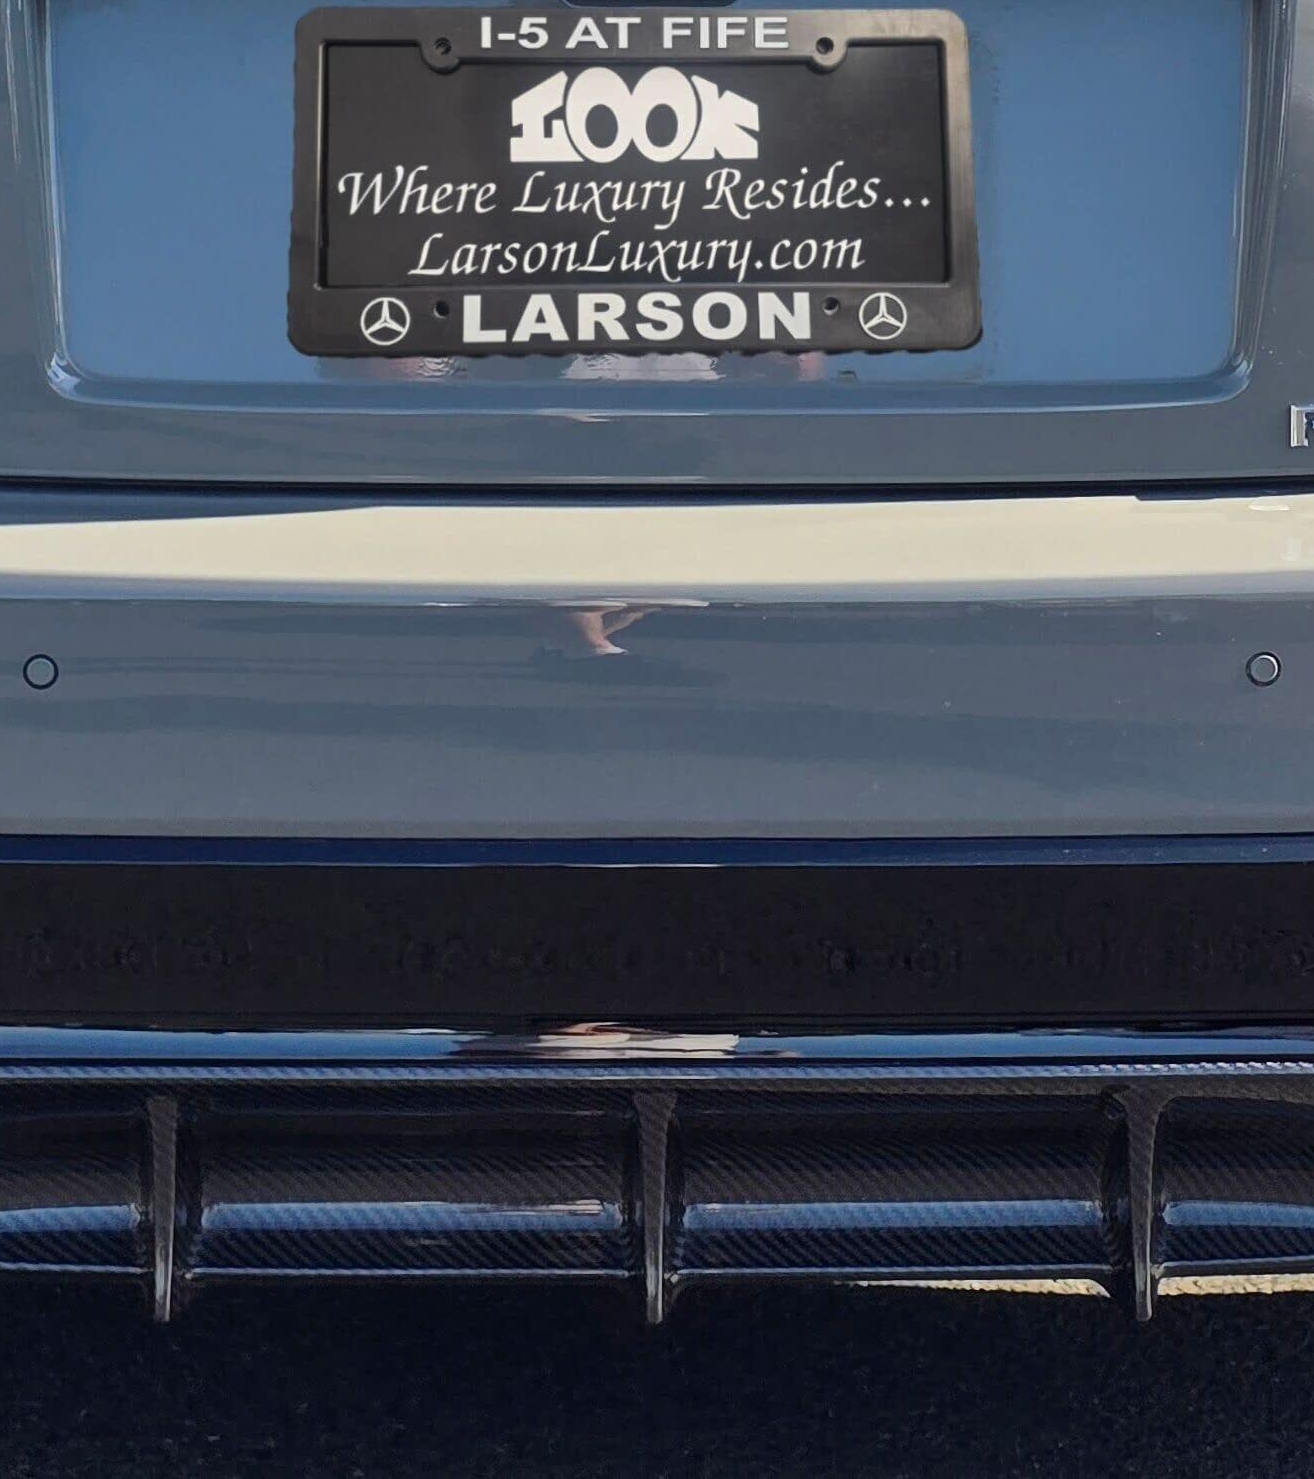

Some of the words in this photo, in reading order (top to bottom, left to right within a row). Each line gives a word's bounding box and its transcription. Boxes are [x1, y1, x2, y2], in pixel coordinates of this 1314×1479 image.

[480, 16, 549, 49] I-5
[564, 16, 642, 49] AT
[662, 16, 790, 49] FIFE
[509, 66, 760, 163] LOOK
[337, 165, 497, 215] Where
[512, 170, 686, 230] Luxury
[703, 161, 932, 219] Resides...
[407, 230, 866, 283] LarsonLuxury.com
[462, 291, 811, 343] LARSON
